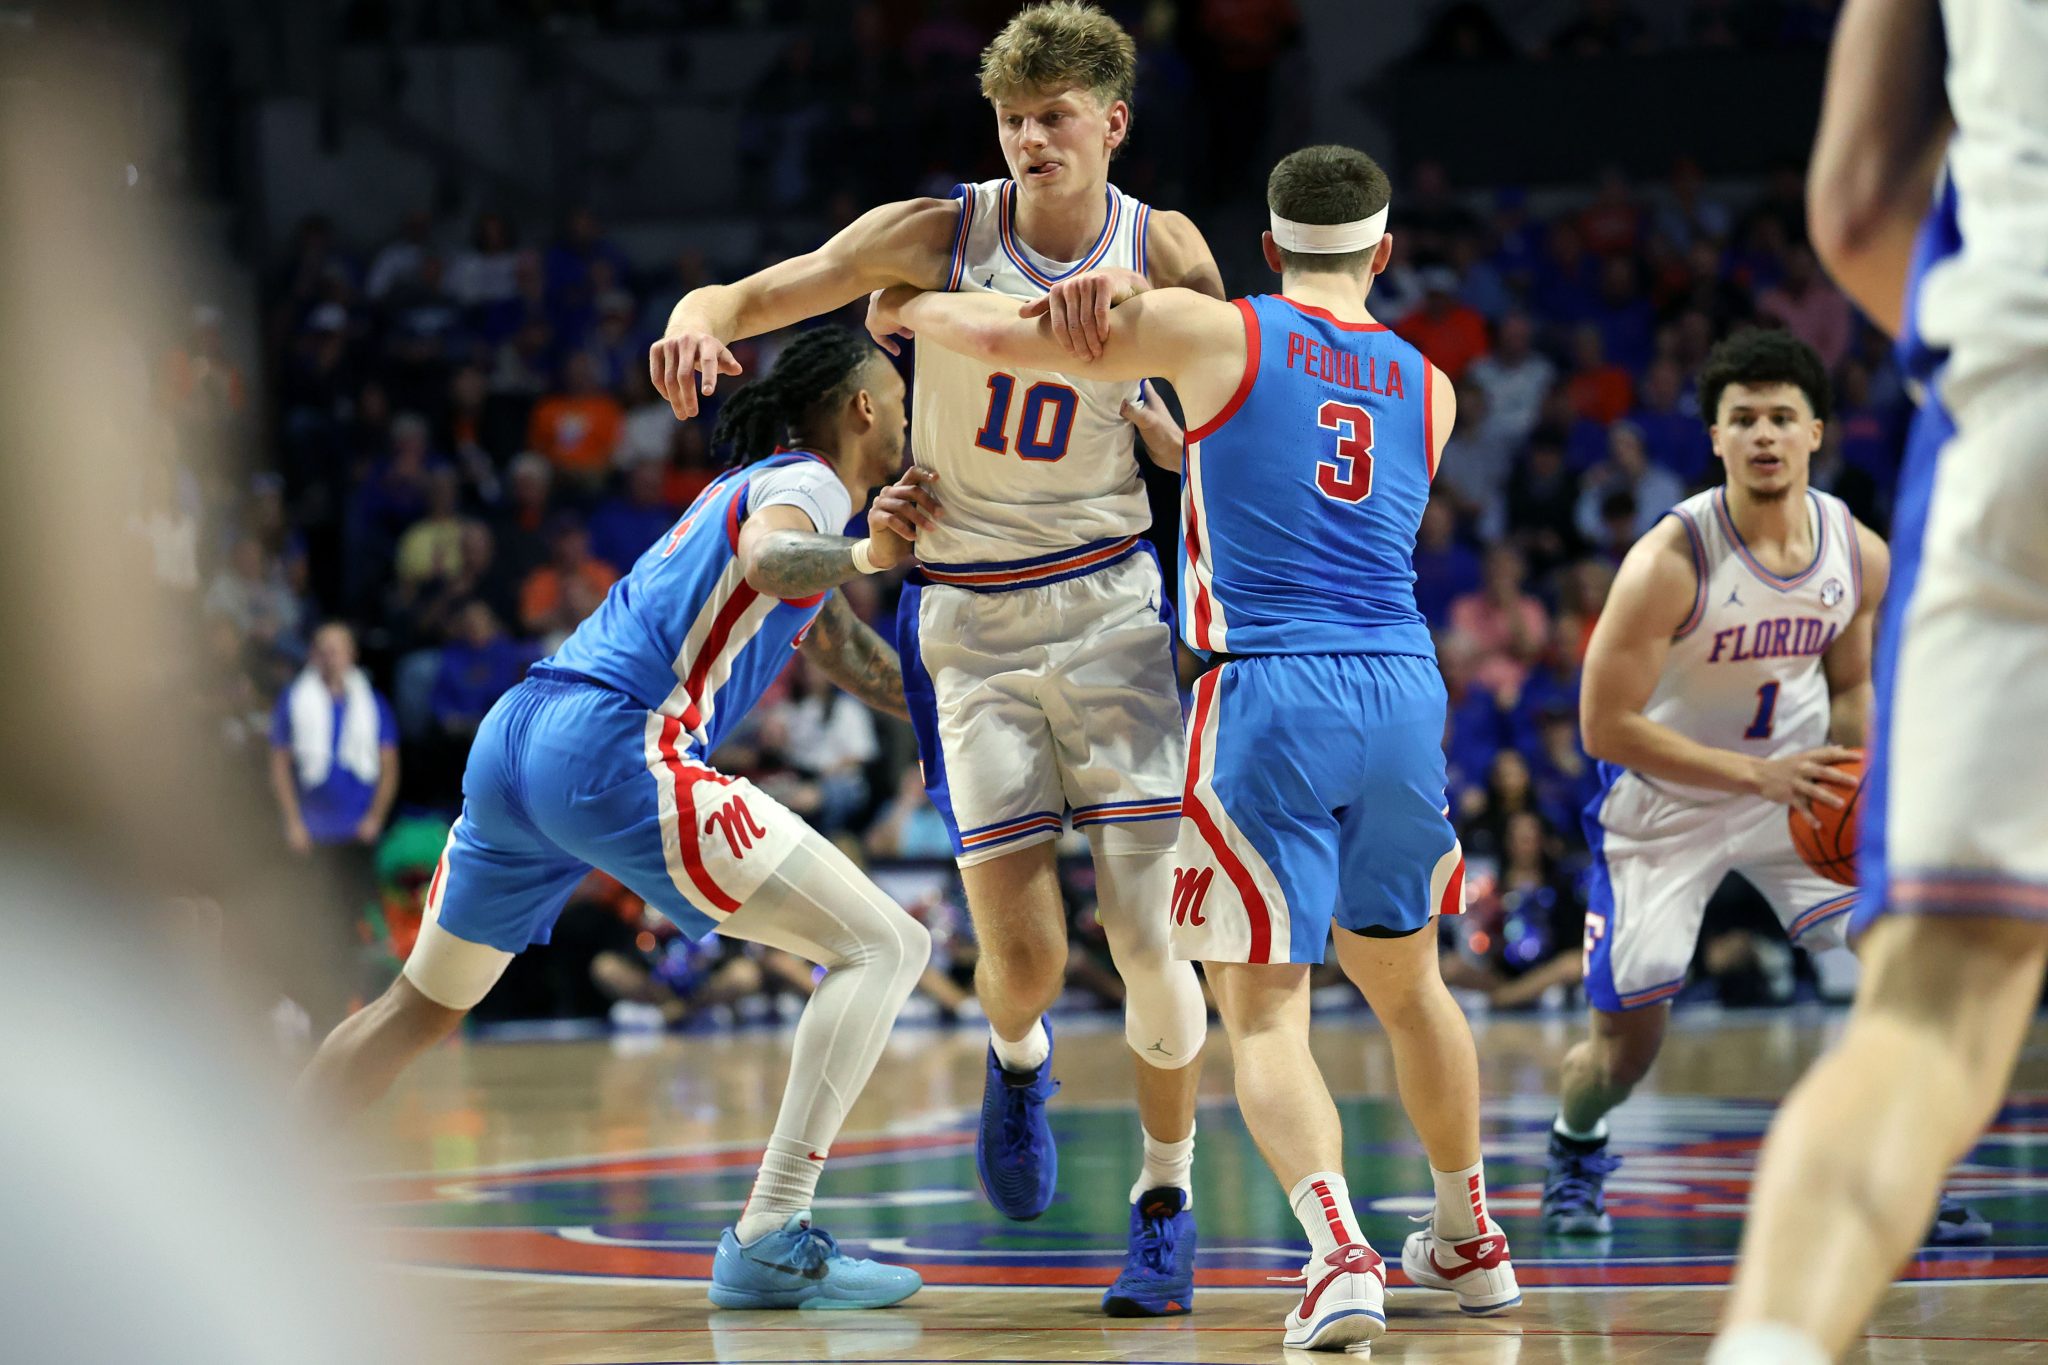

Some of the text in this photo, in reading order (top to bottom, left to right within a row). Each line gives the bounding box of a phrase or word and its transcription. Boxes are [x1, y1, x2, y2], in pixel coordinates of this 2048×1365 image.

[1286, 331, 1404, 400] PEDULLA
[975, 371, 1080, 463] 10
[1315, 399, 1375, 505] 3
[1743, 680, 1781, 740] 1
[705, 794, 767, 860] M
